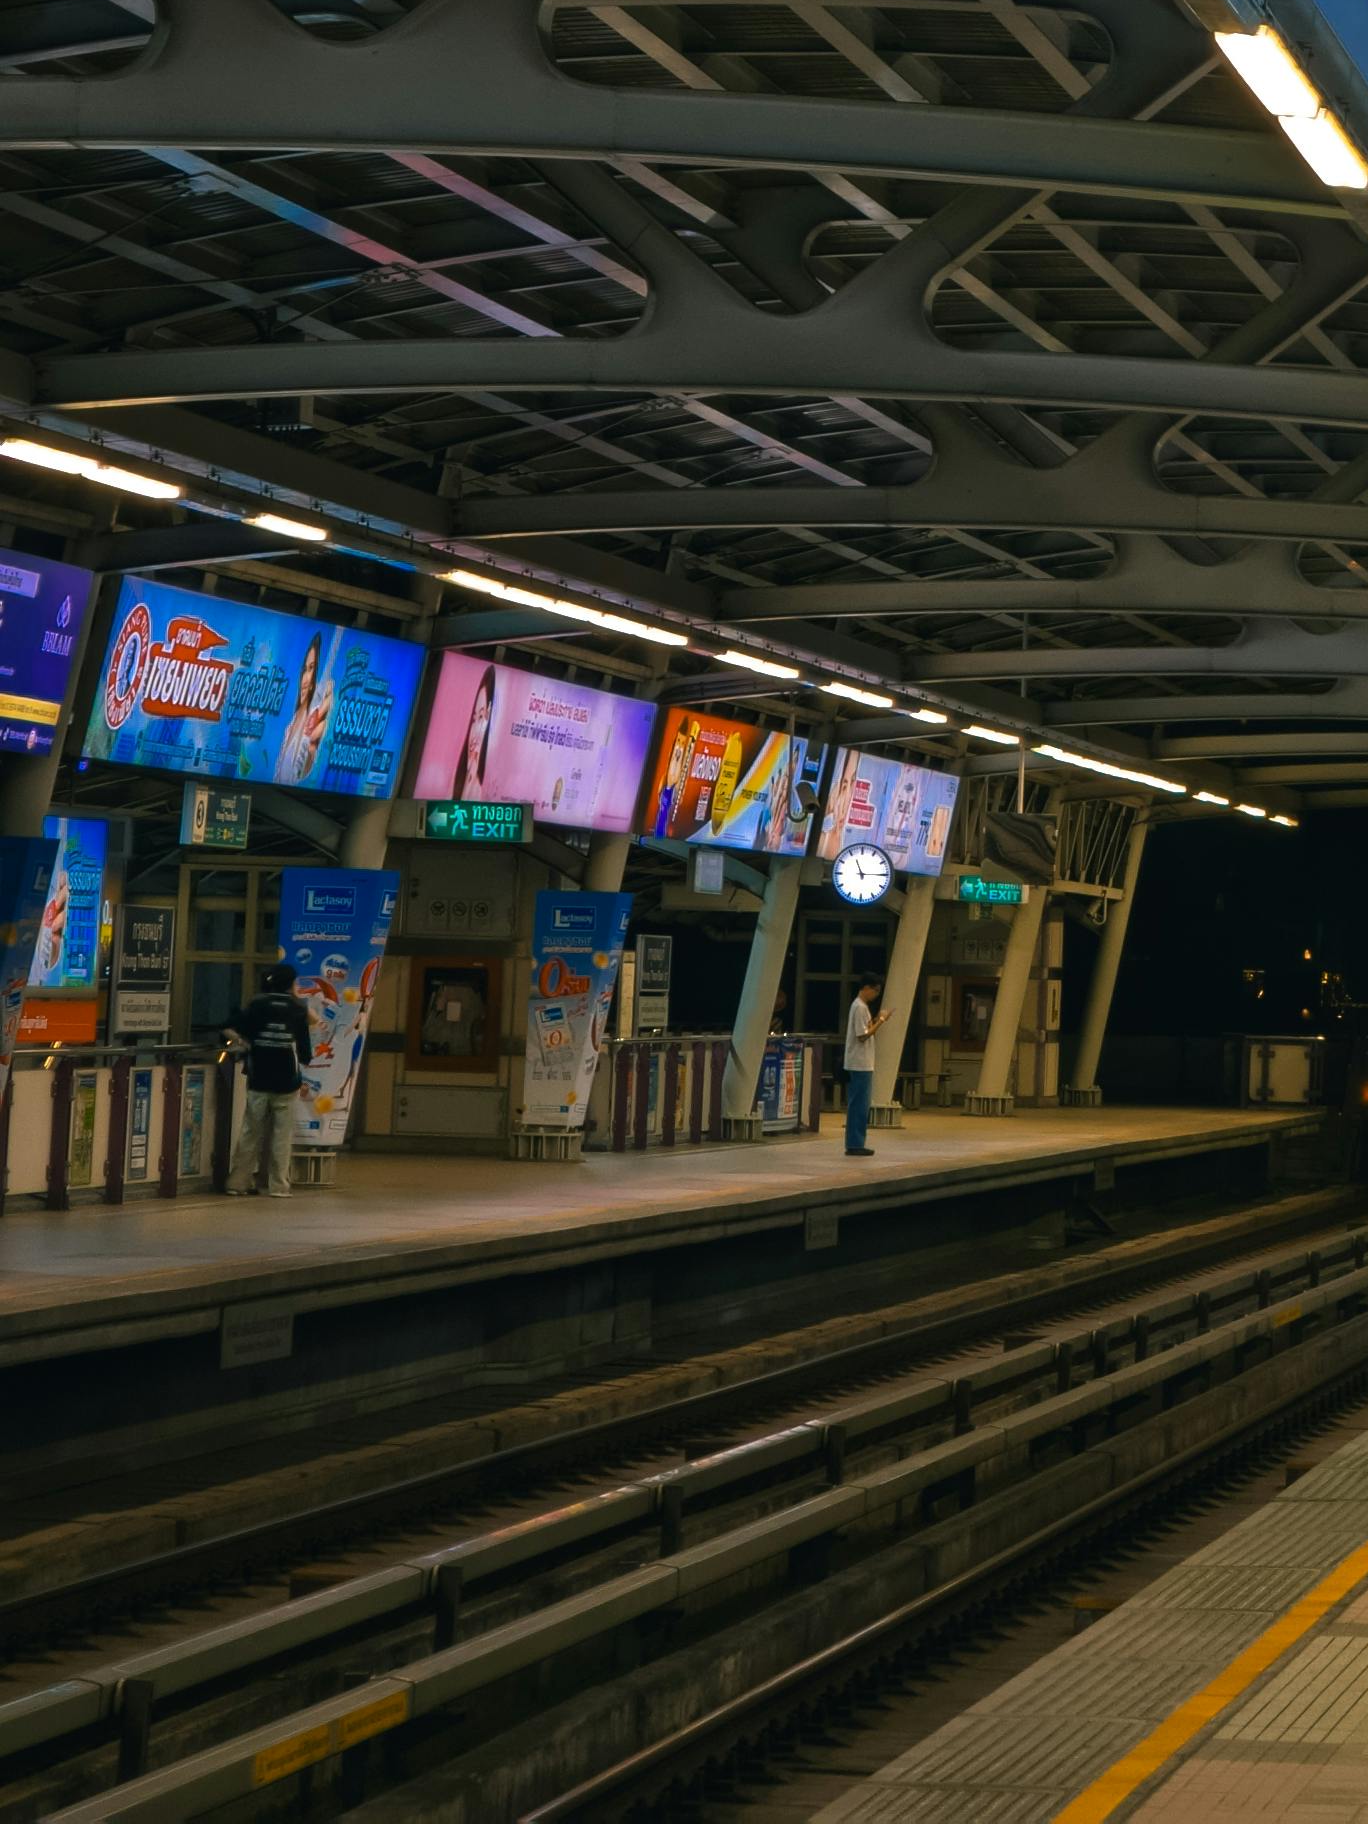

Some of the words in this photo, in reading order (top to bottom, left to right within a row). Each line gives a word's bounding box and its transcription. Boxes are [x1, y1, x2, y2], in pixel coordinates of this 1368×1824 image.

[471, 804, 522, 822] ทางออก
[471, 822, 519, 838] EXIT
[306, 890, 353, 912] Lactasoy
[988, 890, 1022, 901] EXIT
